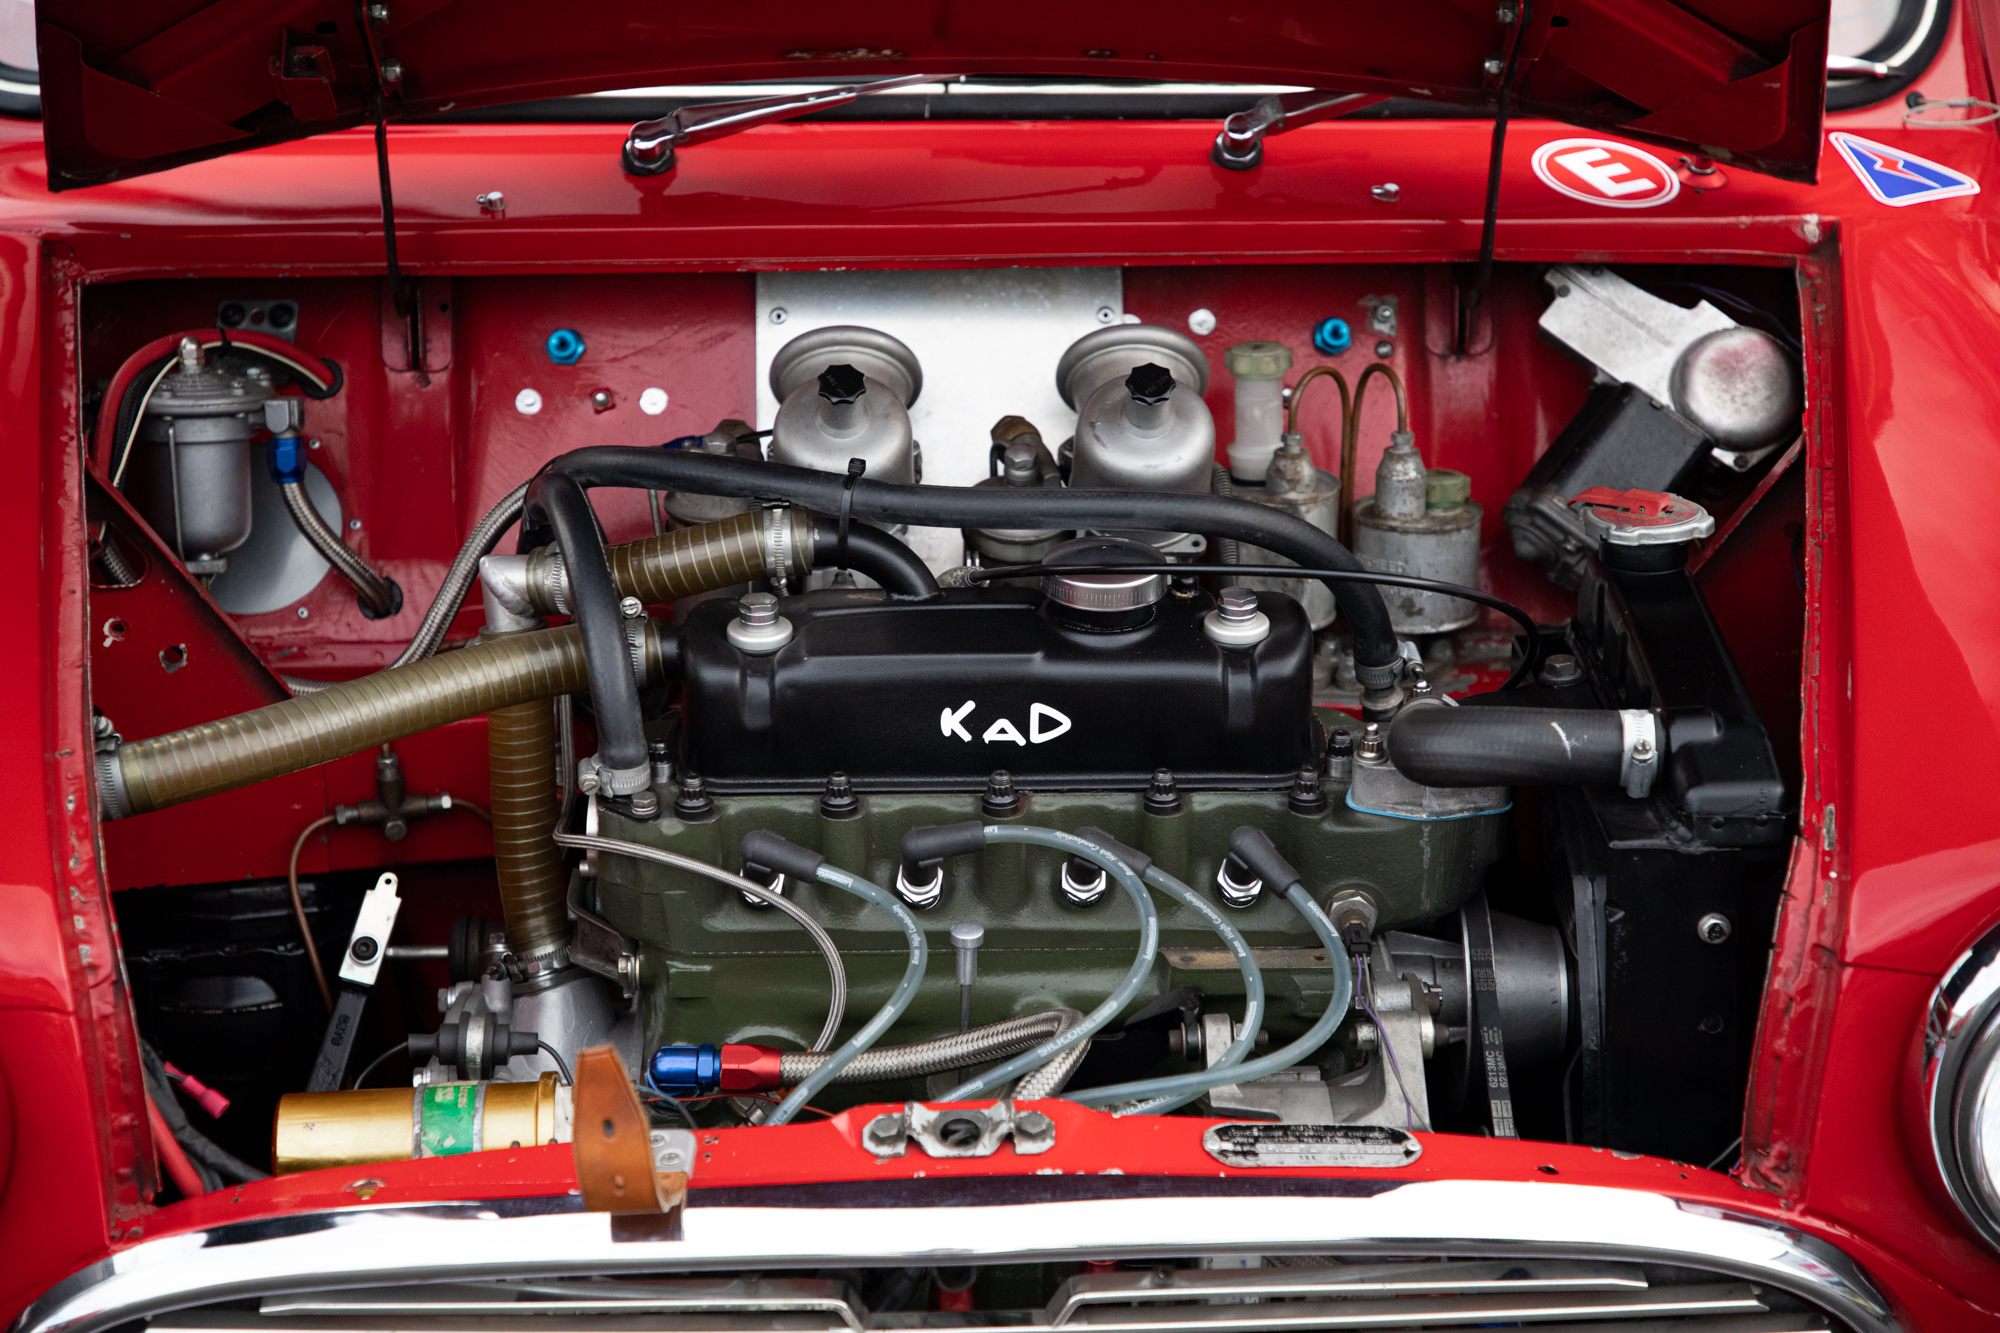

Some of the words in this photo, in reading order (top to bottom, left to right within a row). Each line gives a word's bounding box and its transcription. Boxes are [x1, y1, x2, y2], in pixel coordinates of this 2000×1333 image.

[1553, 147, 1658, 197] E
[940, 700, 1072, 746] KAD
[1054, 830, 1100, 851] Conductivity
[1099, 848, 1117, 862] High
[892, 904, 917, 933] Conductivity
[1183, 892, 1222, 925] Conductivity
[911, 933, 921, 947] High
[1219, 924, 1235, 940] High
[1233, 940, 1246, 958] 8mm
[1037, 1018, 1096, 1058] SILICONE
[1485, 1050, 1499, 1088] 6213MC
[1496, 1050, 1508, 1088] 6213MC
